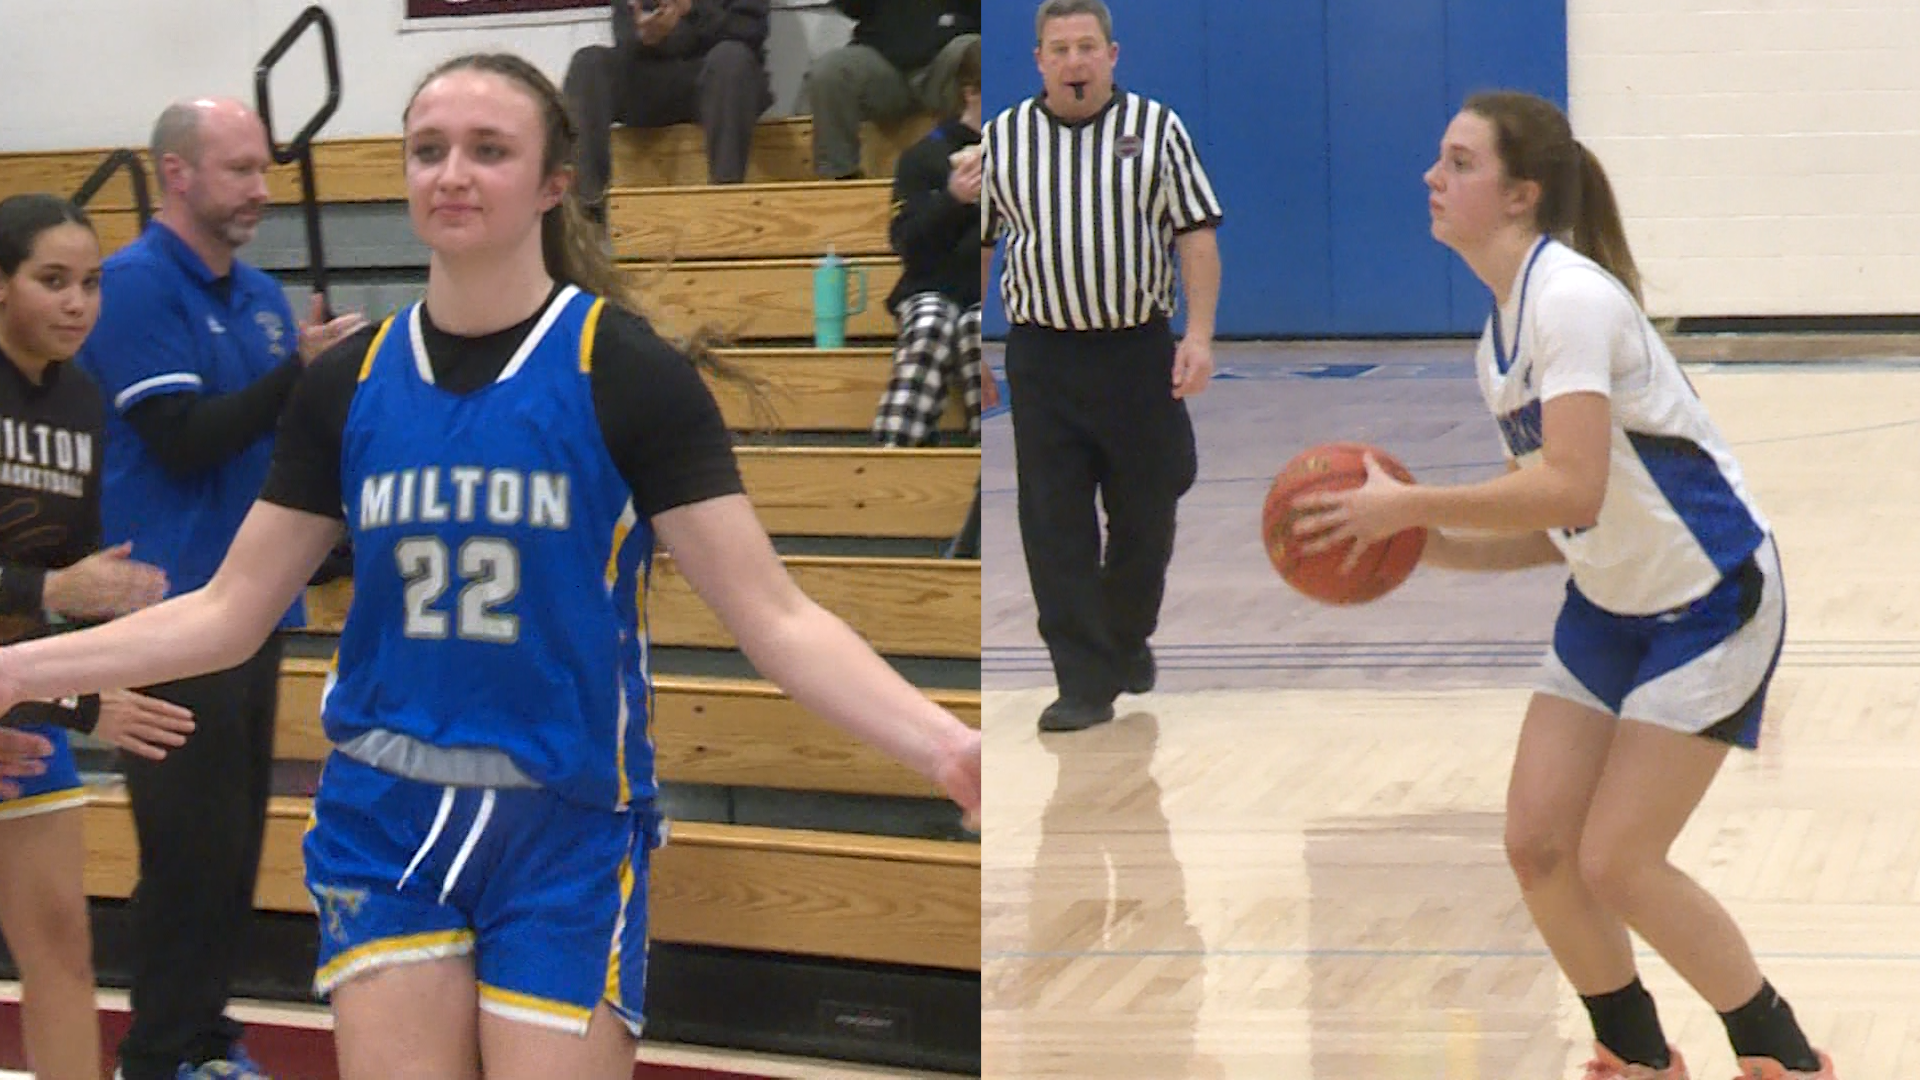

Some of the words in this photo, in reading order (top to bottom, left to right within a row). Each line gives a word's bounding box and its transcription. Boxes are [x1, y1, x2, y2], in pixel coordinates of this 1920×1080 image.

[0, 417, 93, 475] ILTON
[0, 460, 84, 498] ASKETBALL
[359, 465, 571, 531] MILTON
[394, 535, 519, 645] 22
